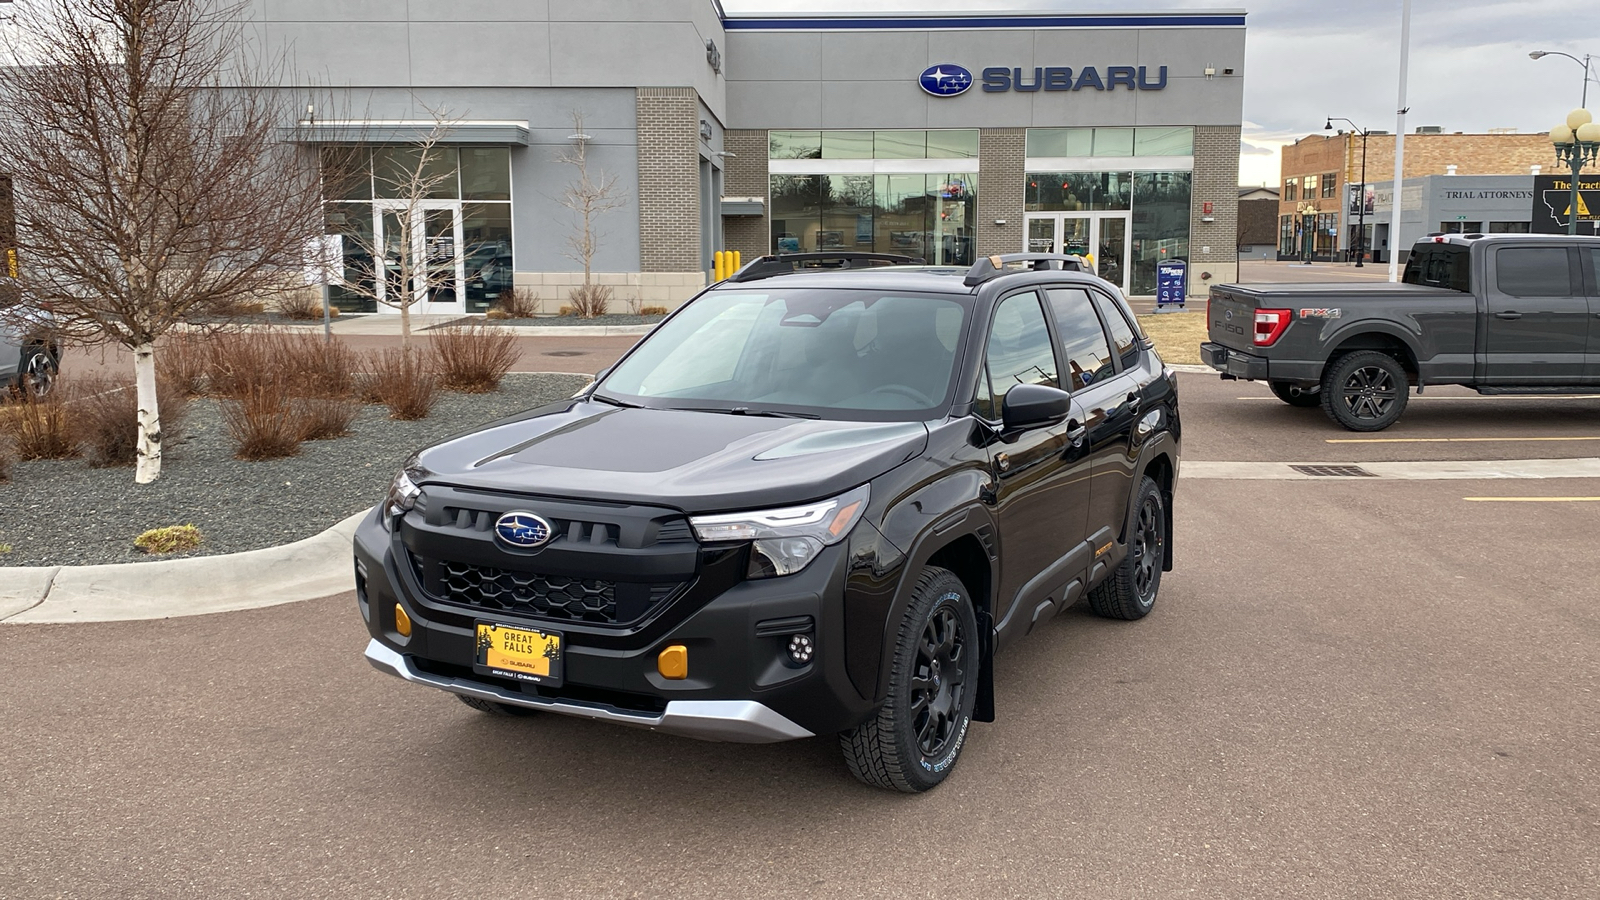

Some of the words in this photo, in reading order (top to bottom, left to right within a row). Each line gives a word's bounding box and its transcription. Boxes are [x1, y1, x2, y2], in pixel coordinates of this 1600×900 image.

[982, 65, 1168, 92] SUBARU
[1553, 180, 1572, 189] The
[1446, 191, 1475, 199] TRIAL
[1477, 191, 1533, 199] ATTORNEYS
[1300, 308, 1341, 318] FX4
[1214, 321, 1244, 336] F-150
[504, 632, 533, 644] GREAT
[504, 641, 533, 654] FALLS
[509, 660, 536, 669] SUBARU
